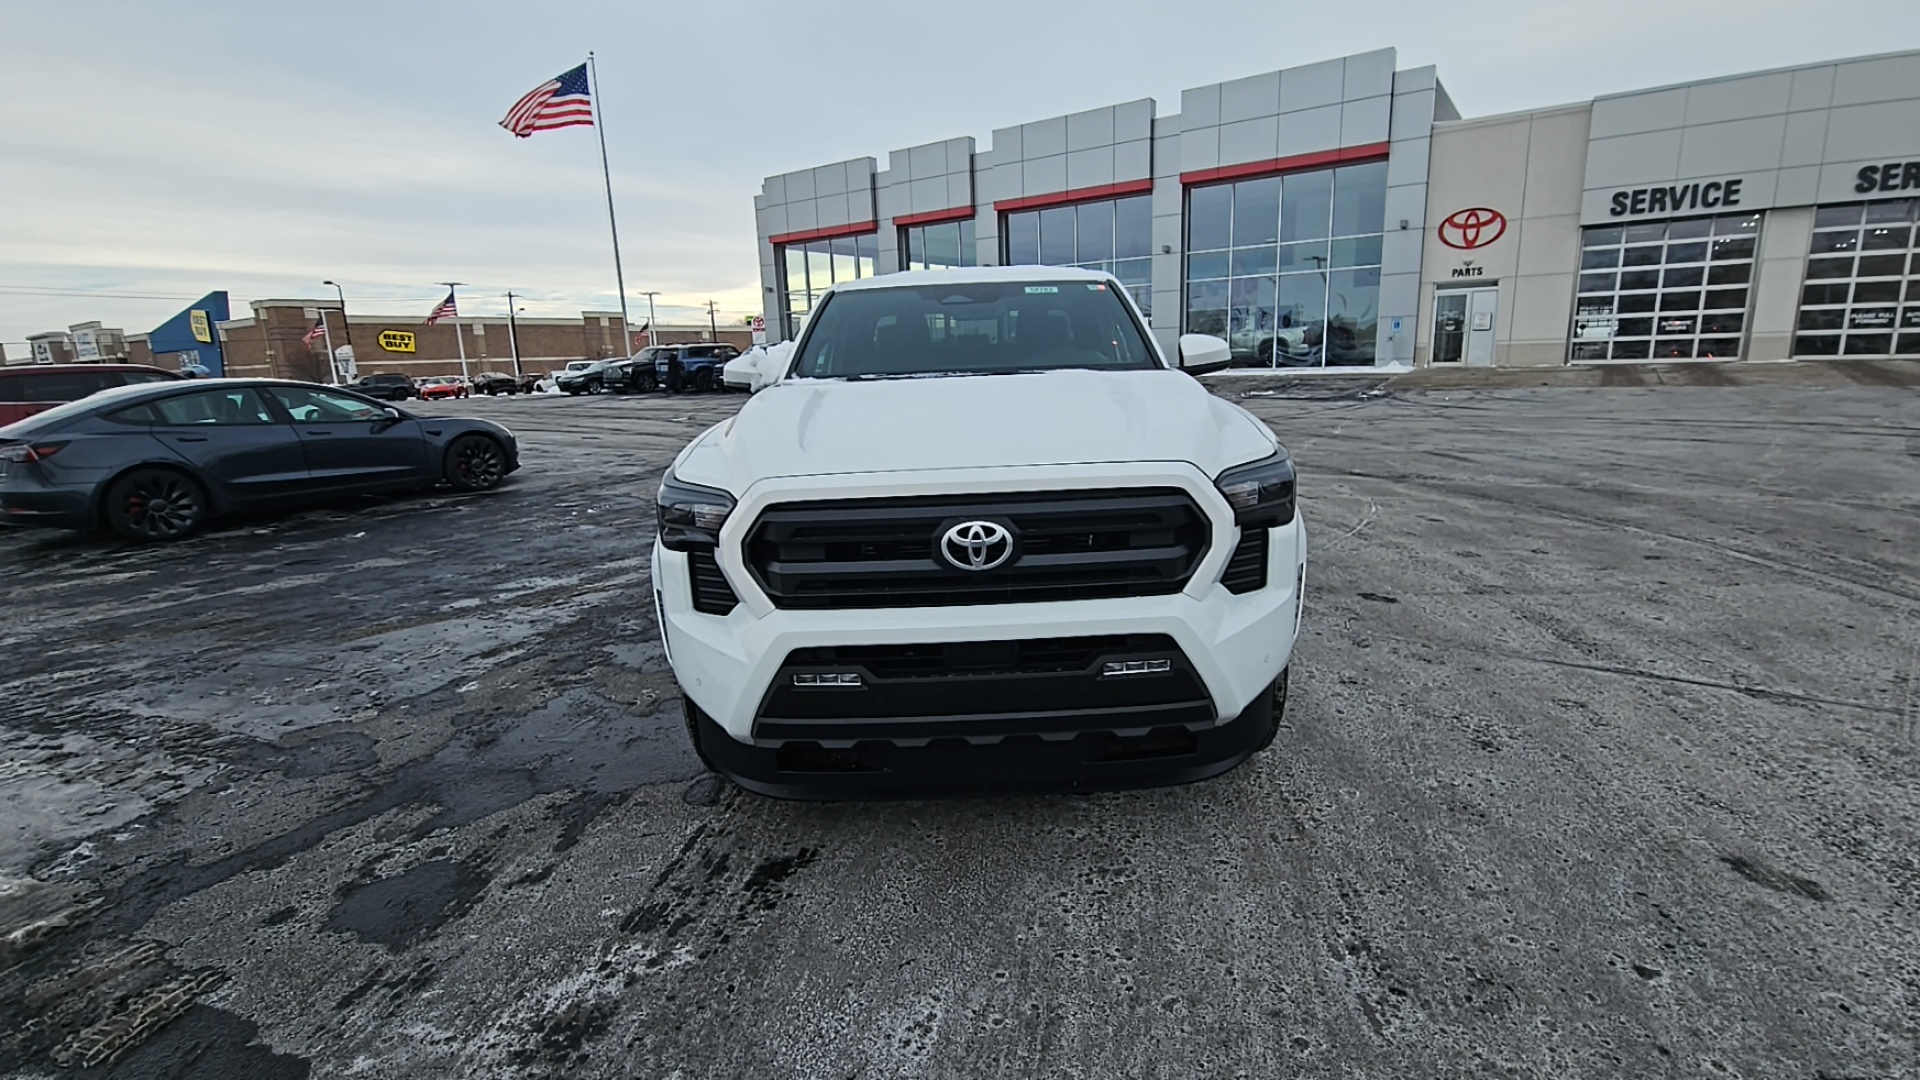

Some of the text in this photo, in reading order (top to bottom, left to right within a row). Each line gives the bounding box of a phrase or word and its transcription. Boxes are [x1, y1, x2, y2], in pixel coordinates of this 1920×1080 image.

[1855, 162, 1920, 194] SER
[1610, 179, 1743, 216] SERVICE
[1452, 267, 1483, 277] PARTS
[383, 333, 412, 341] BEST
[385, 341, 410, 349] BUY
